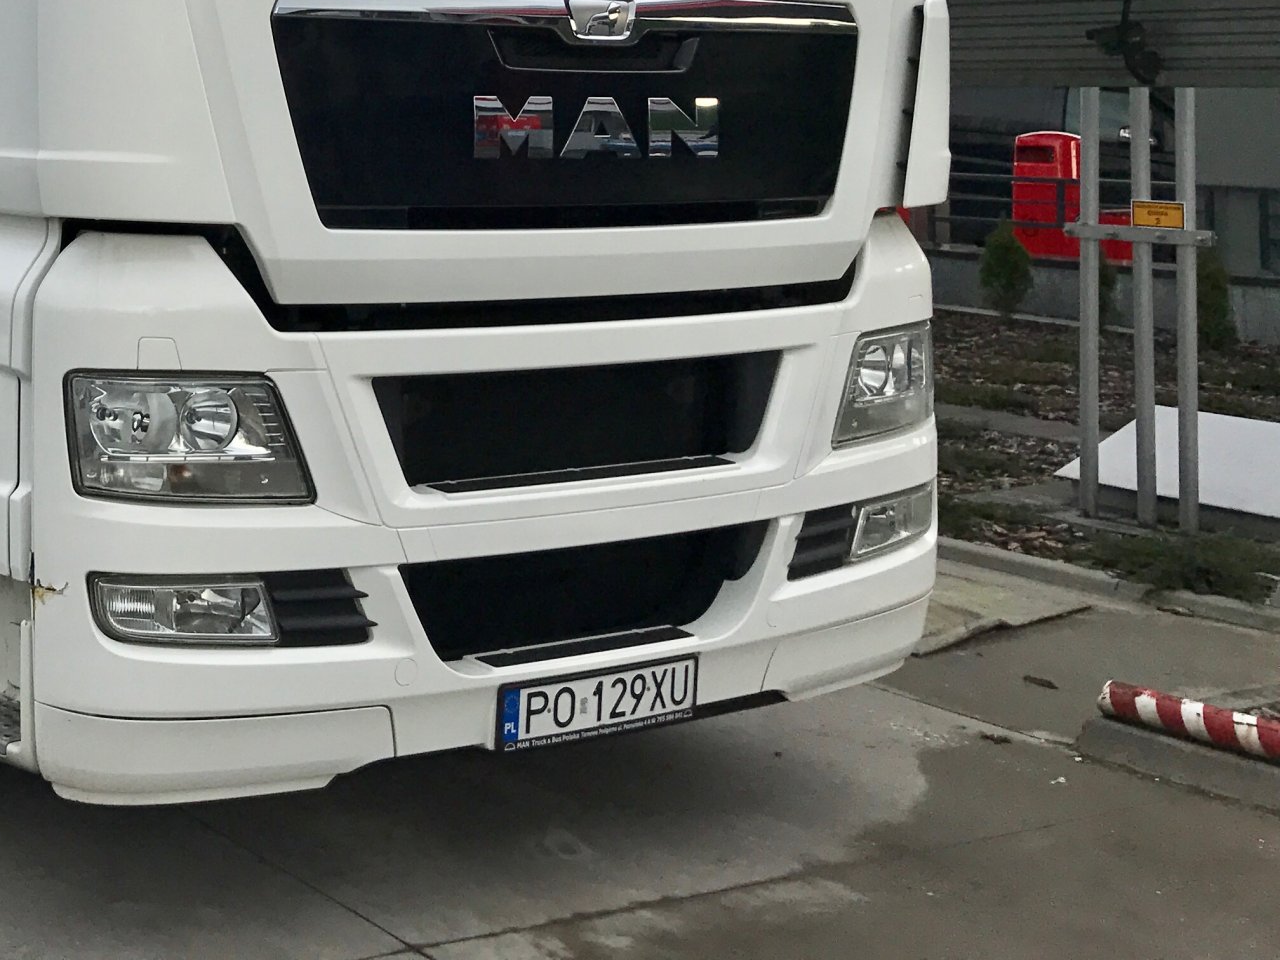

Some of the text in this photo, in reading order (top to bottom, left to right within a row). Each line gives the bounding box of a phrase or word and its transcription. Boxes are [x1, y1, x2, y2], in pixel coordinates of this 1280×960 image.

[473, 96, 718, 159] MAN
[504, 722, 516, 735] PL
[525, 664, 689, 734] PO 129XU
